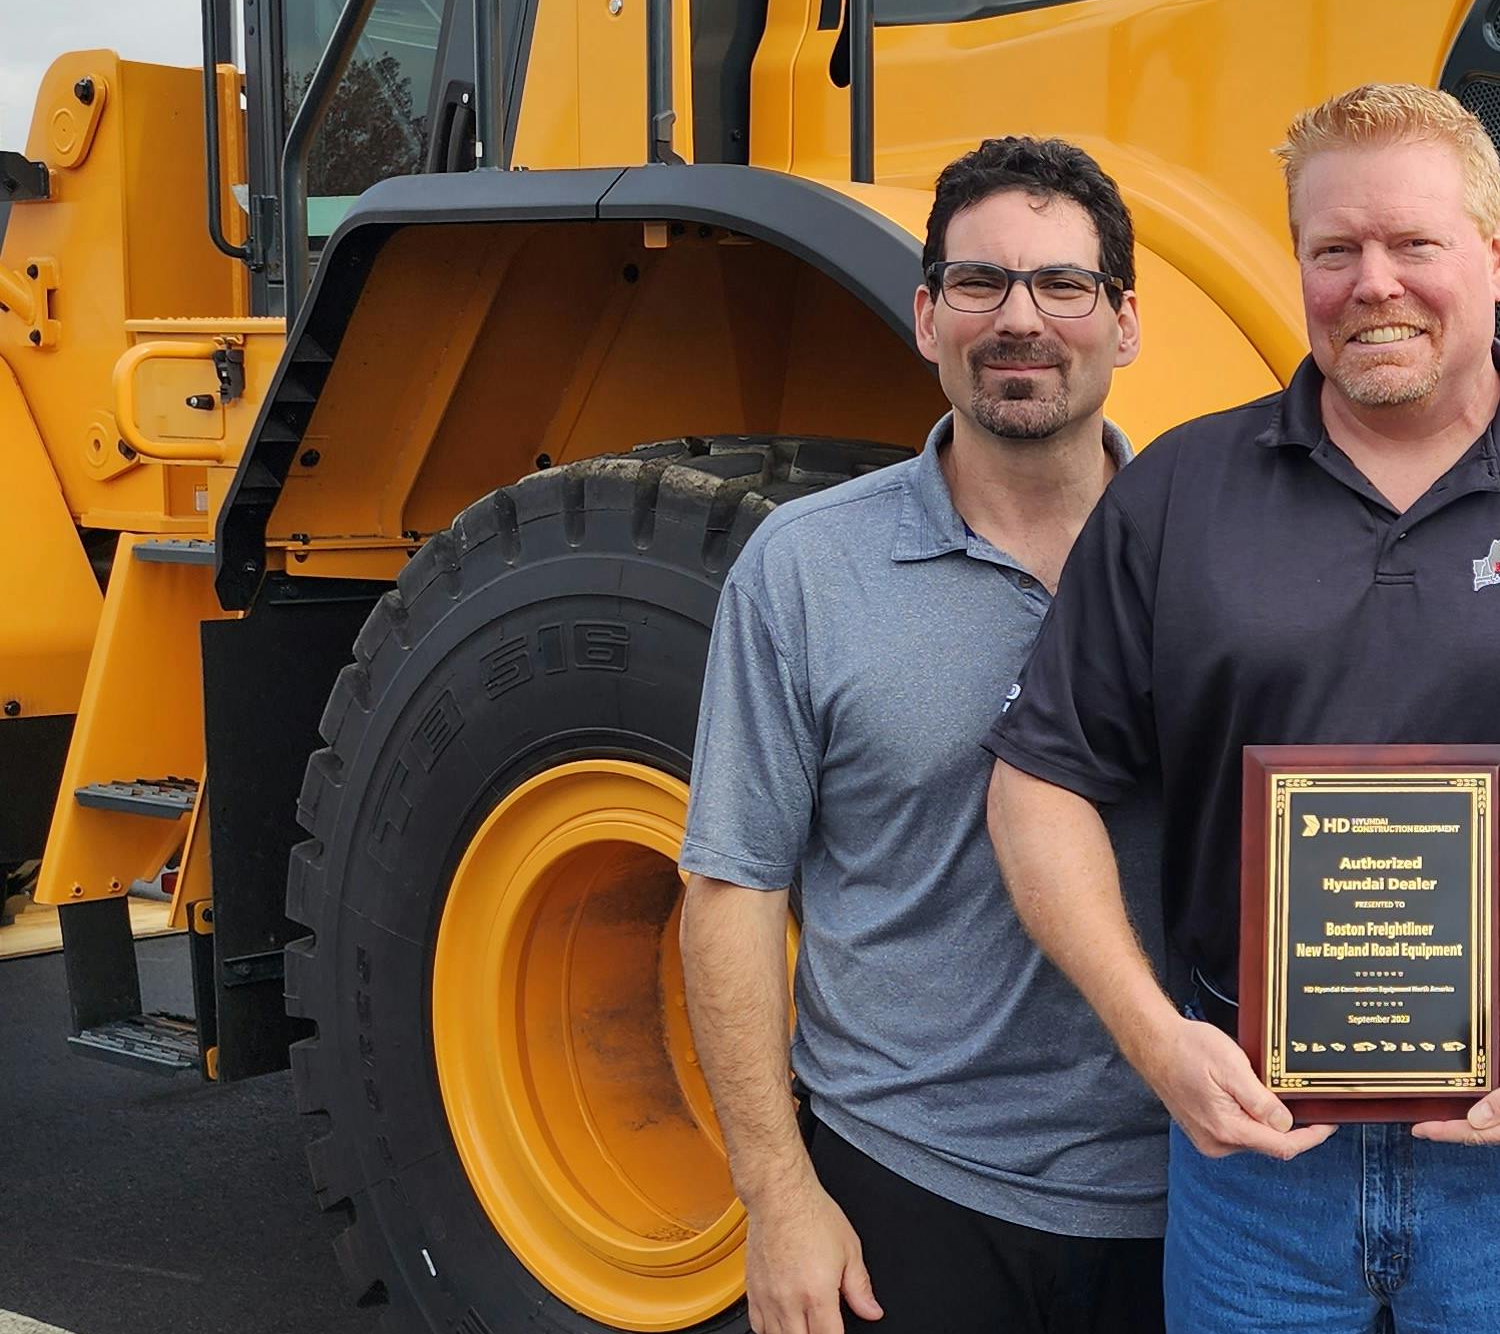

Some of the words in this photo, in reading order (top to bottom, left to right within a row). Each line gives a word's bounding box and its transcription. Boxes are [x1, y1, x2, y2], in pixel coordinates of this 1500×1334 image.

[479, 620, 631, 701] 516
[1323, 818, 1350, 833] HD
[1351, 825, 1414, 833] CONSTRUCTION
[1414, 825, 1461, 833] EQUIPMENT
[1339, 856, 1423, 870] Authorized
[1323, 877, 1385, 893] Hyundai
[1388, 877, 1438, 890] Dealer
[1326, 922, 1366, 936] Boston
[1367, 922, 1434, 939] Freightliner
[1296, 943, 1322, 957] New
[1323, 943, 1369, 960] England
[1371, 943, 1400, 957] Road
[1401, 943, 1463, 960] Equipment
[1348, 1015, 1391, 1025] September
[1391, 1015, 1410, 1024] 2023
